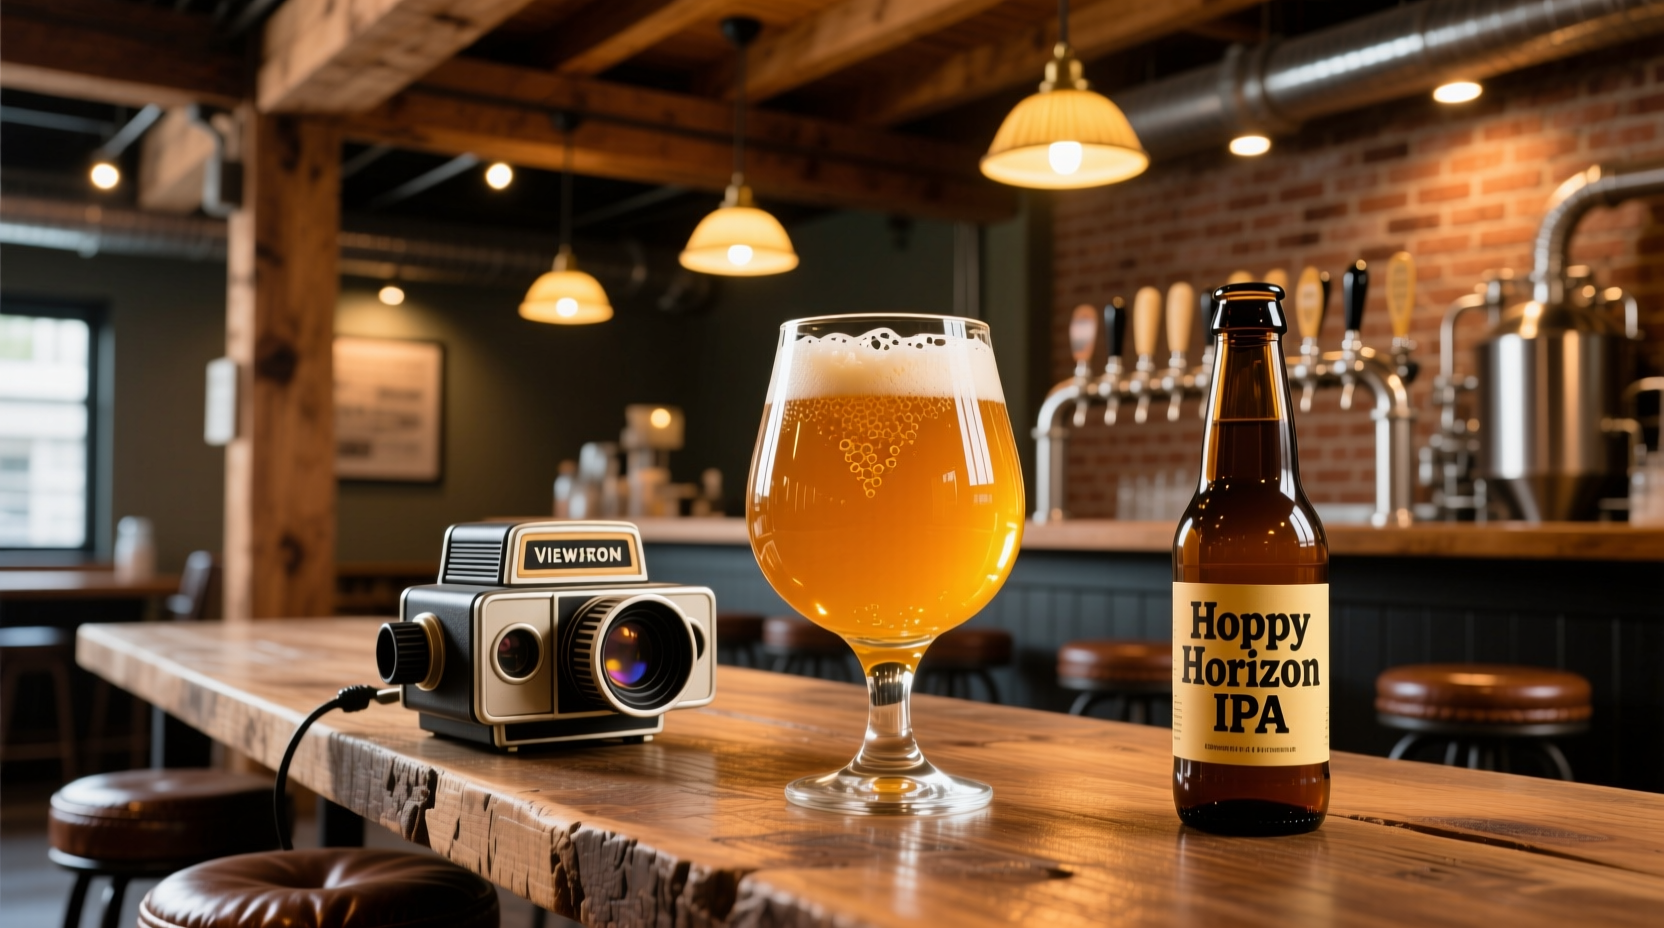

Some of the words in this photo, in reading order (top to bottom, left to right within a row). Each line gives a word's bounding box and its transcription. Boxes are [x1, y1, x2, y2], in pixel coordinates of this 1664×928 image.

[1190, 601, 1311, 652] Hoppy
[1182, 645, 1321, 688] Horizon
[1213, 693, 1290, 734] IPA
